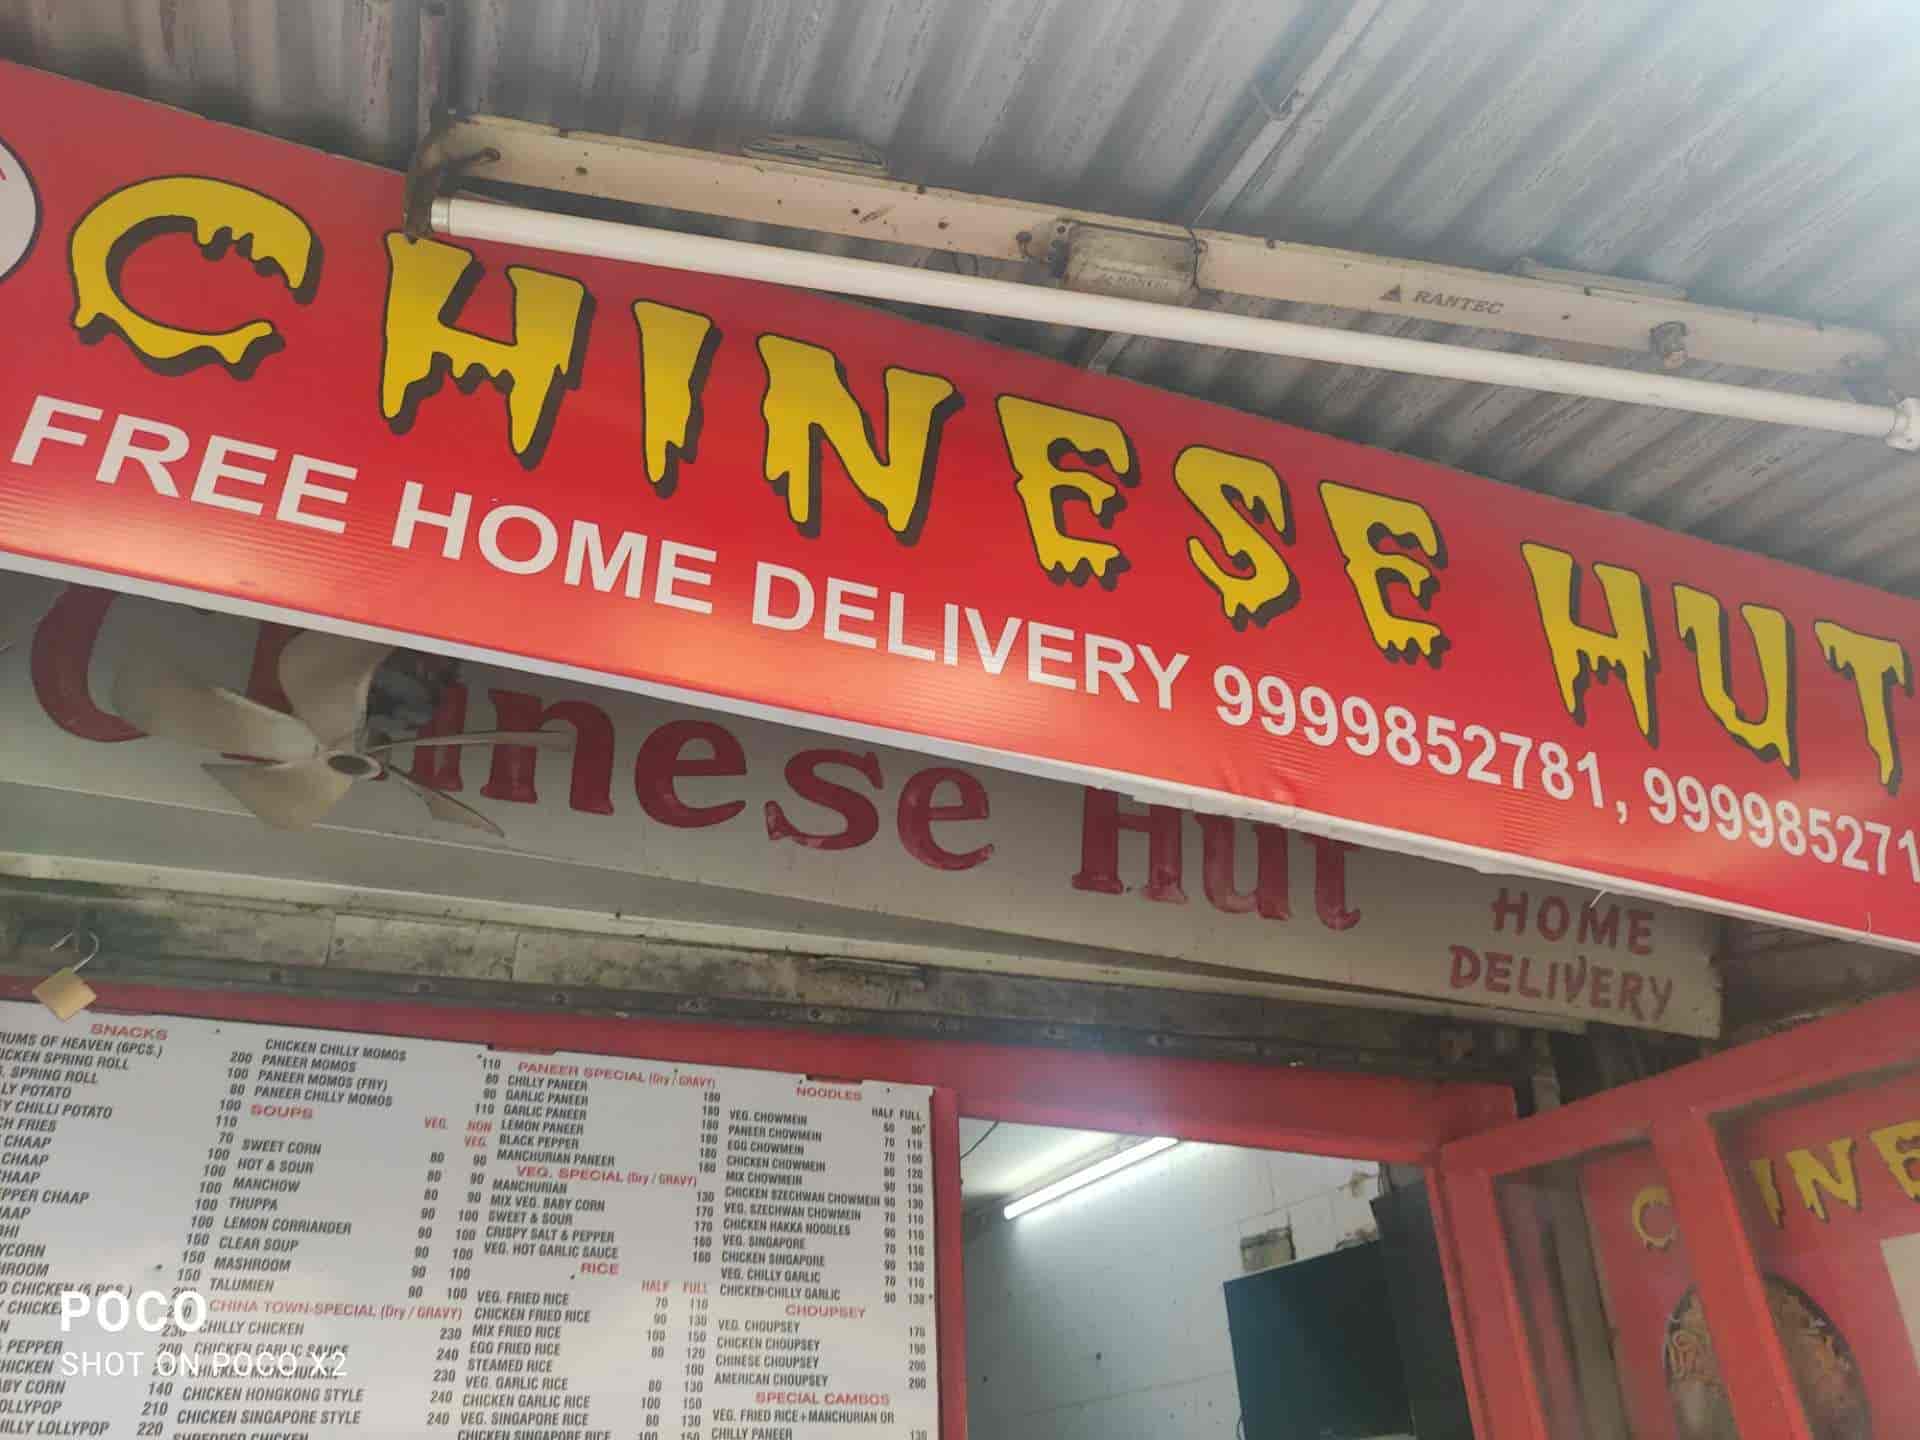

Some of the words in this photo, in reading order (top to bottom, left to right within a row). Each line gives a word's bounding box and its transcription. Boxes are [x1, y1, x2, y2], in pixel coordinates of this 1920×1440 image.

[67, 174, 1451, 668] CHINESE
[1519, 541, 1914, 797] HUT
[10, 394, 358, 534] FREE
[391, 480, 718, 615] HOME
[751, 561, 1190, 710] DELIVERY
[1213, 664, 1628, 825] 9999852781,
[1072, 788, 1361, 931] Hut
[1491, 887, 1655, 956] HOME
[1448, 944, 1673, 1022] DELIVERY
[90, 1023, 168, 1040] SNACKS
[61, 1037, 113, 1052] HEAVEN
[265, 1039, 317, 1052] CHICKEN
[320, 1043, 360, 1057] CHILLY
[363, 1048, 407, 1061] MOMOS
[44, 1051, 93, 1067] SPRING
[262, 1054, 308, 1069] PANEER
[311, 1059, 356, 1073] MOMOS
[10, 1066, 61, 1081] SPRING
[518, 1061, 578, 1076] PANEER
[584, 1065, 644, 1083] SPECIAL
[258, 1071, 305, 1085] PANEER
[307, 1074, 353, 1089] MOMOS
[508, 1076, 545, 1089] CHILLY
[547, 1078, 587, 1091] PANEER
[20, 1084, 72, 1099] POTATO
[254, 1086, 301, 1100] PANEER
[304, 1090, 345, 1104] CHILLY
[348, 1094, 393, 1107] MOMOS
[506, 1091, 545, 1103] GARLIC
[548, 1093, 588, 1106] PANEER
[795, 1087, 863, 1101] NOODLES
[62, 1104, 113, 1119] POTATO
[250, 1104, 313, 1119] SOUPS
[504, 1105, 543, 1118] GARLIC
[545, 1108, 587, 1120] PANEER
[754, 1112, 808, 1126] CHOWMEIN
[17, 1118, 57, 1132] FRIES
[501, 1120, 540, 1132] LEMON
[543, 1123, 584, 1135] PANEER
[728, 1125, 766, 1138] PANEER
[768, 1128, 823, 1142] CHOWMEIN
[4, 1135, 52, 1149] CHAAP
[241, 1138, 284, 1154] SWEET
[287, 1141, 322, 1156] CORN
[499, 1135, 534, 1146] BLACK
[537, 1137, 579, 1150] PEPPER
[727, 1140, 748, 1152] EGG
[750, 1142, 805, 1156] CHOWMEIN
[497, 1149, 570, 1165] MANCHURIAN
[573, 1153, 615, 1166] PANEER
[726, 1155, 769, 1169] CHICKEN
[771, 1158, 826, 1172] CHOWMEIN
[237, 1158, 264, 1171] HOT
[279, 1160, 314, 1174] SOUR
[558, 1167, 623, 1183] SPECIAL
[725, 1171, 745, 1183] MIX
[748, 1172, 803, 1186] CHOWMEIN
[232, 1177, 300, 1193] MANCHOW
[492, 1179, 567, 1195] MANCHURIAN
[42, 1190, 91, 1205] CHAAP
[228, 1196, 278, 1212] THUPPA
[490, 1194, 513, 1207] MIX
[543, 1197, 573, 1210] BABY
[575, 1199, 605, 1212] CORN
[725, 1186, 768, 1200] CHICKEN
[827, 1192, 881, 1207] CHOWMEIN
[488, 1211, 527, 1224] SWEET
[541, 1213, 573, 1225] SOUR
[808, 1206, 861, 1221] CHOWMEIN
[223, 1216, 268, 1231] LEMON
[271, 1218, 352, 1235] CORRIANDER
[723, 1218, 767, 1231] CHICKEN
[769, 1221, 803, 1233] HAKKA
[806, 1223, 850, 1236] NOODLES
[486, 1226, 528, 1240] CRISPY
[530, 1229, 558, 1241] SALT
[572, 1230, 615, 1243] PEPPER
[219, 1236, 260, 1251] CLEAR
[263, 1238, 299, 1252] SOUP
[749, 1236, 805, 1249] SINGAPORE
[512, 1244, 535, 1256] HOT
[539, 1245, 579, 1258] GARLIC
[582, 1247, 619, 1259] SAUCE
[721, 1251, 766, 1265] CHICKEN
[769, 1253, 825, 1266] SINGAPORE
[213, 1256, 292, 1272] MASHROOM
[580, 1262, 620, 1275] RICE
[747, 1269, 781, 1281] CHILLY
[785, 1270, 820, 1283] GARLIC
[209, 1277, 274, 1293] TALUMIEN
[506, 1291, 540, 1305] FRIED
[543, 1293, 569, 1306] RICE
[804, 1287, 841, 1301] GARLIC
[208, 1299, 258, 1313] CHINA
[785, 1304, 865, 1319] CHOUPSEY
[474, 1308, 526, 1321] CHICKEN
[528, 1309, 562, 1322] FRIED
[564, 1310, 591, 1323] RICE
[248, 1322, 304, 1336] CHICKEN
[439, 1328, 462, 1340] 230
[471, 1324, 495, 1337] MIX
[498, 1324, 532, 1338] FRIED
[535, 1326, 561, 1339] RICE
[744, 1320, 800, 1334] CHOUPSEY
[7, 1340, 64, 1355] PEPPER
[469, 1341, 493, 1354] EGG
[497, 1342, 531, 1355] FRIED
[534, 1343, 561, 1356] RICE
[716, 1337, 762, 1349] CHICKEN
[765, 1338, 820, 1351] CHOUPSEY
[436, 1349, 458, 1361] 240
[715, 1355, 761, 1368] CHINESE
[764, 1356, 819, 1369] CHOUPSEY
[467, 1358, 523, 1372] STEAMED
[526, 1360, 553, 1373] RICE
[433, 1370, 455, 1382] 230
[495, 1377, 539, 1390] GARLIC
[541, 1378, 569, 1390] RICE
[714, 1373, 770, 1386] AMERICAN
[773, 1374, 828, 1387] CHOUPSEY
[25, 1380, 66, 1394] CORN
[148, 1382, 173, 1397] 140
[182, 1388, 241, 1402] CHICKEN
[245, 1388, 320, 1402] HONGKONG
[324, 1389, 364, 1402] STYLE
[430, 1391, 452, 1404] 240
[462, 1394, 515, 1407] CHICKEN
[518, 1395, 560, 1408] GARLIC
[564, 1395, 591, 1409] RICE
[755, 1392, 818, 1404] SPECIAL
[824, 1393, 890, 1406] CAMBOS
[141, 1401, 168, 1417] 210
[740, 1410, 771, 1422] FRIED
[177, 1410, 237, 1424] CHICKEN
[240, 1410, 317, 1424] SINGAPORE
[320, 1411, 361, 1424] STYLE
[427, 1412, 450, 1425] 240
[491, 1412, 559, 1426] SINGAPORE
[562, 1413, 590, 1426] RICE
[37, 1421, 110, 1436] LOLLYPOP
[136, 1422, 163, 1437] 220
